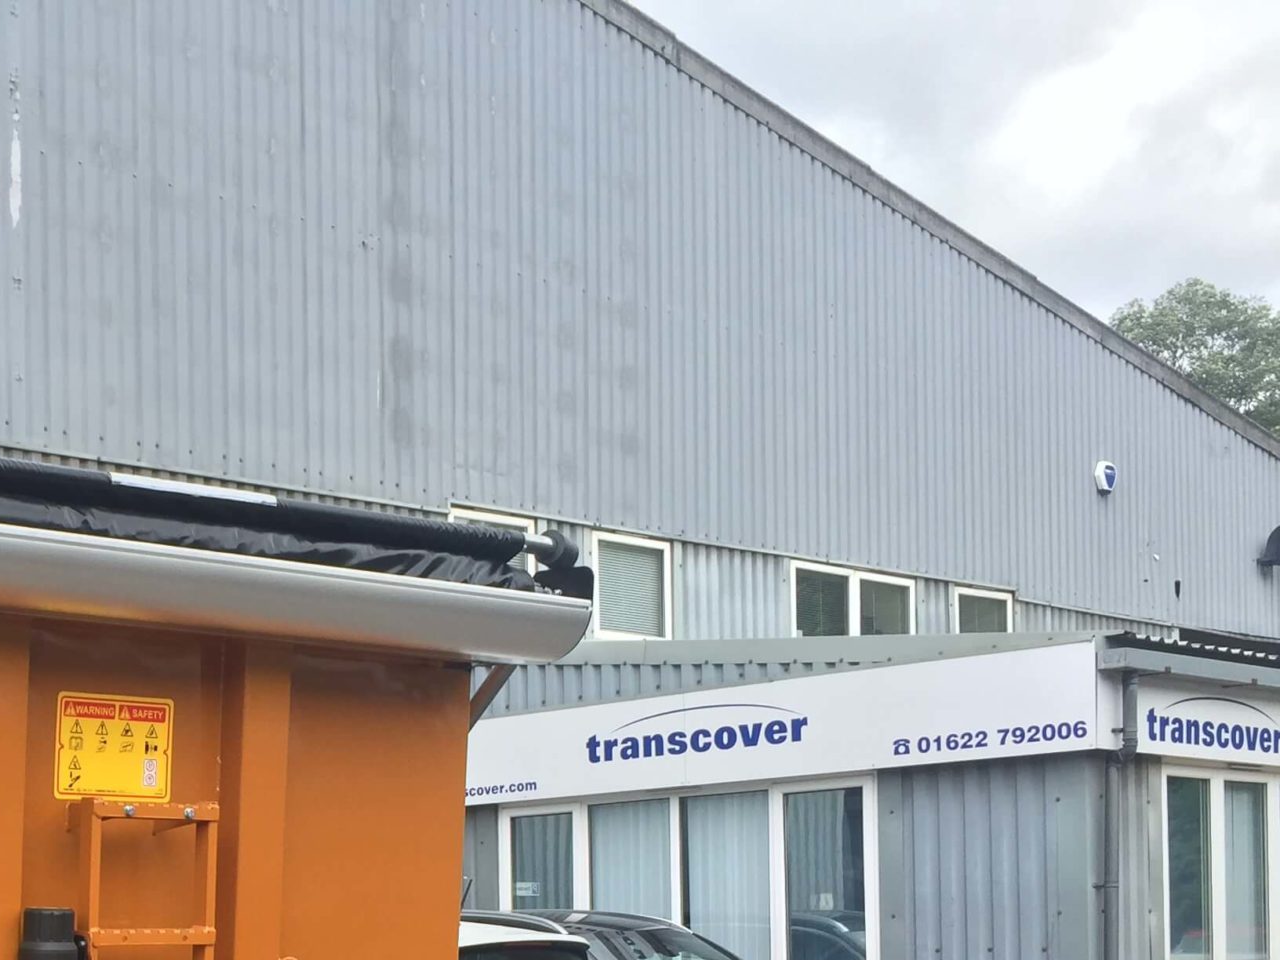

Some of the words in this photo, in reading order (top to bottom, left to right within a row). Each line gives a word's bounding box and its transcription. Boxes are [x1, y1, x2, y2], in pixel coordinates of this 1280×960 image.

[76, 704, 115, 717] WARNING
[132, 708, 163, 720] SAFETY
[586, 714, 808, 764] transcover
[917, 730, 988, 753] 01622
[997, 720, 1087, 746] 792006
[1147, 707, 1280, 754] transcover
